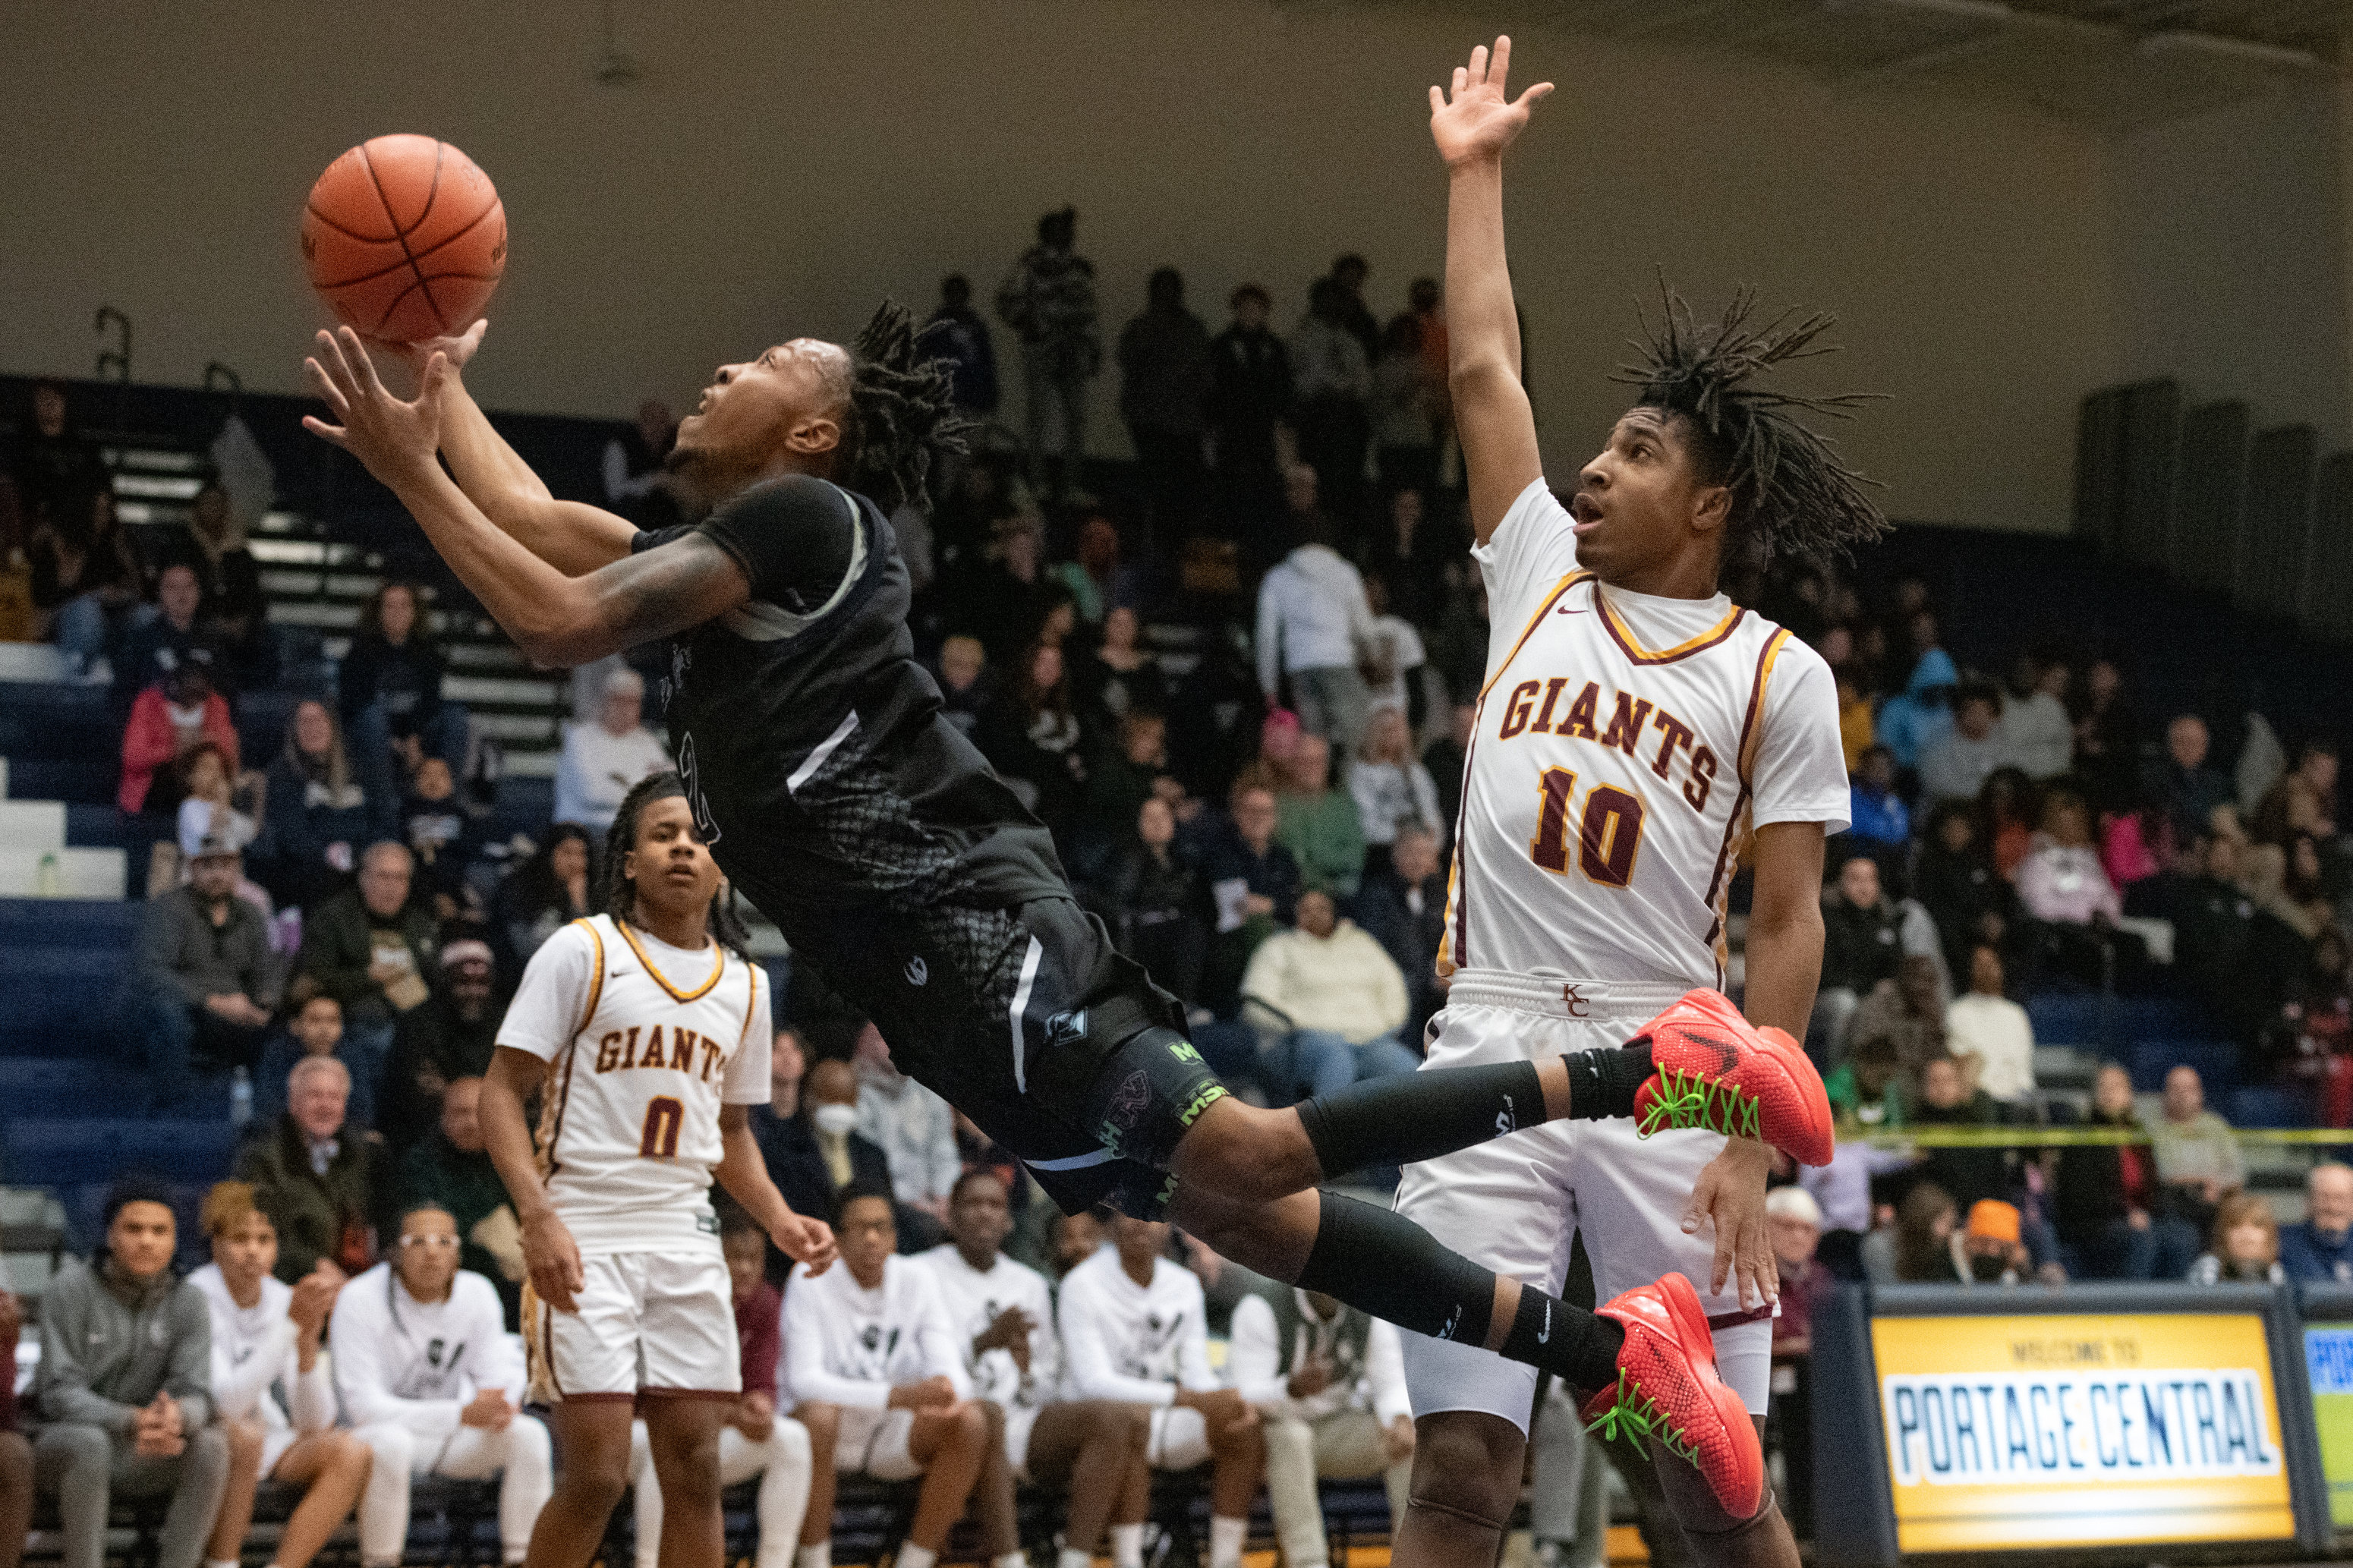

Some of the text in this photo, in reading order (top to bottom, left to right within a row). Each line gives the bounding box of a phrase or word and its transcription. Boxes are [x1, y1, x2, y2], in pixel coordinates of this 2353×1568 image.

[1499, 677, 1717, 813] GIANTS
[1530, 764, 1646, 888] 10
[638, 1094, 685, 1163] 0
[1894, 1380, 2270, 1475] PORTAGE CENTRAL
